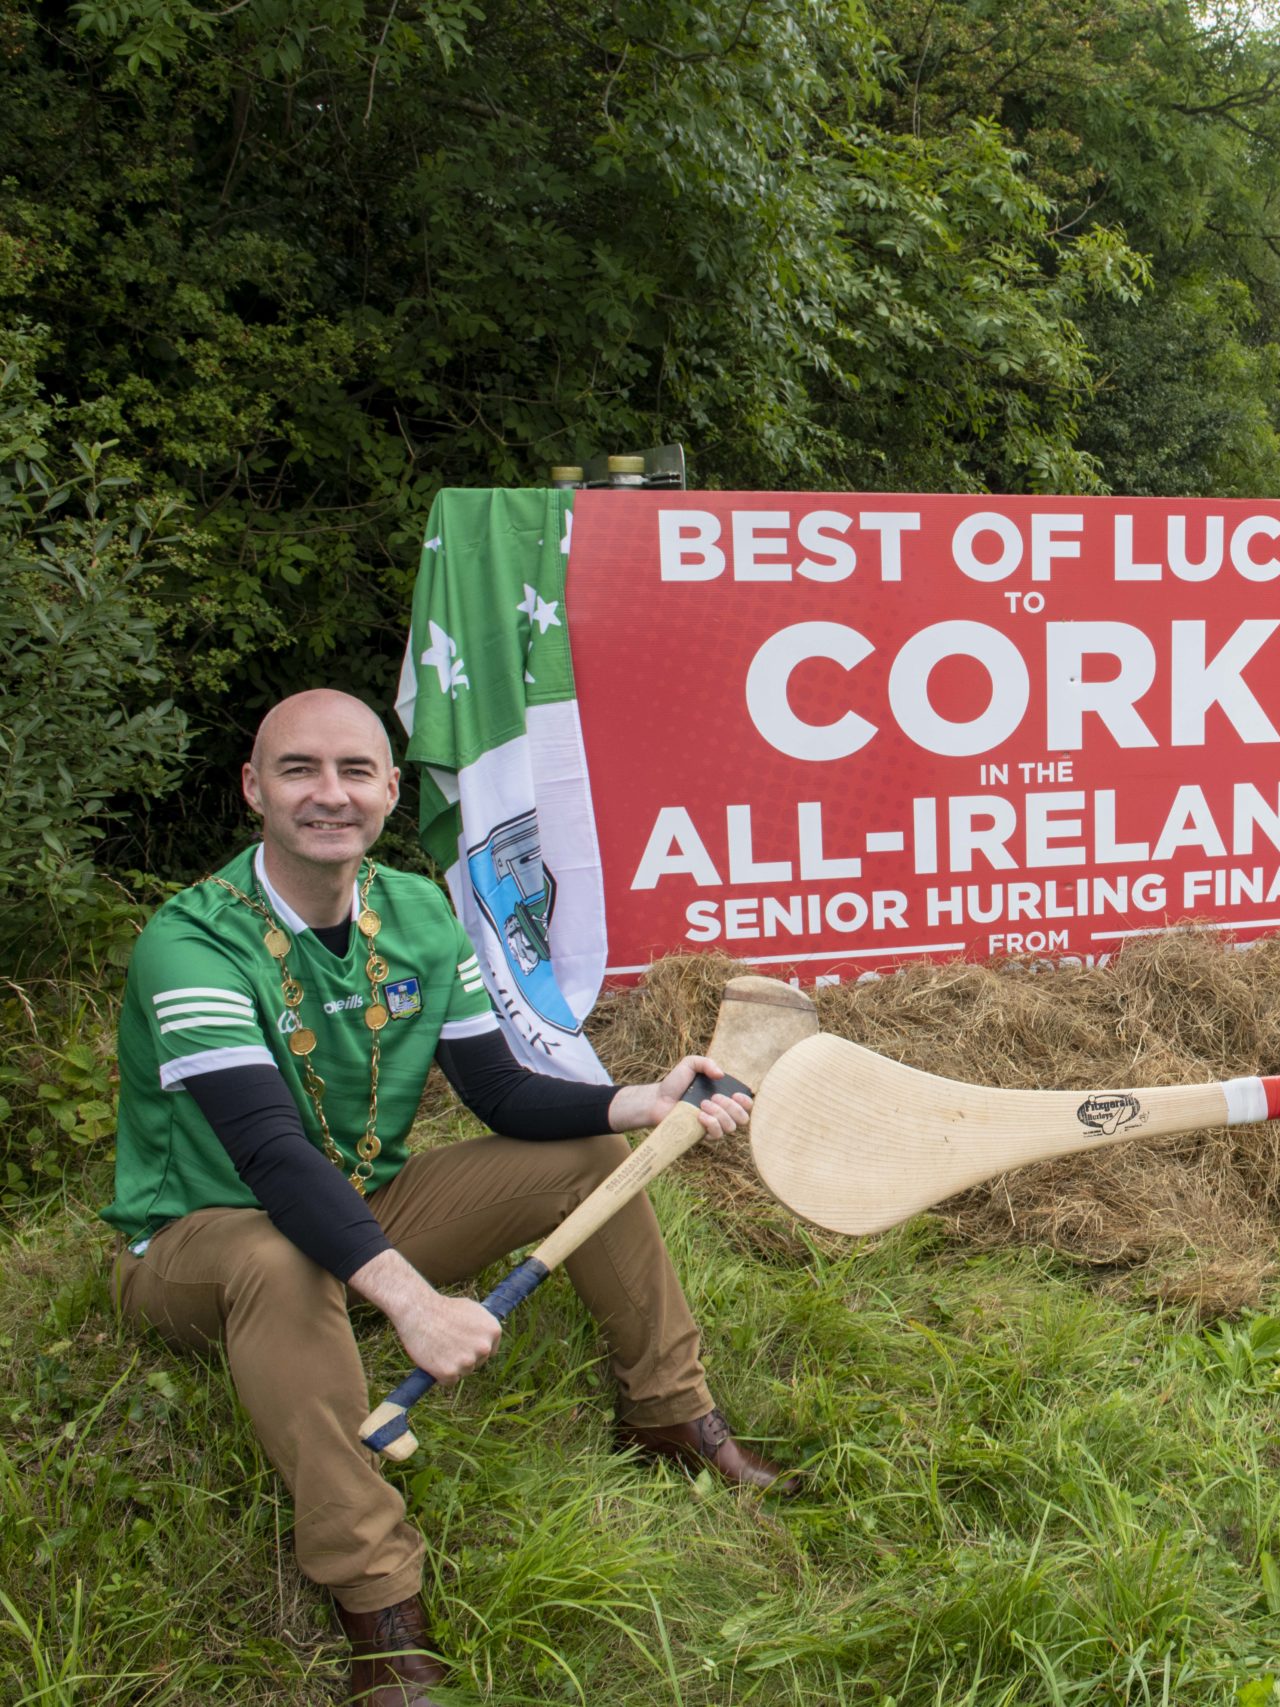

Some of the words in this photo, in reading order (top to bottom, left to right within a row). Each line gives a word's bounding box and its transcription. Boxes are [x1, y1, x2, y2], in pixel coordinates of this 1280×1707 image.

[658, 509, 921, 582] BEST
[951, 511, 1083, 582] OF
[1004, 591, 1045, 614] TO
[980, 763, 1009, 786] IN
[1018, 761, 1074, 784] THE
[686, 890, 909, 942] SENIOR
[926, 873, 1167, 927] HURLING
[988, 929, 1069, 955] FROM
